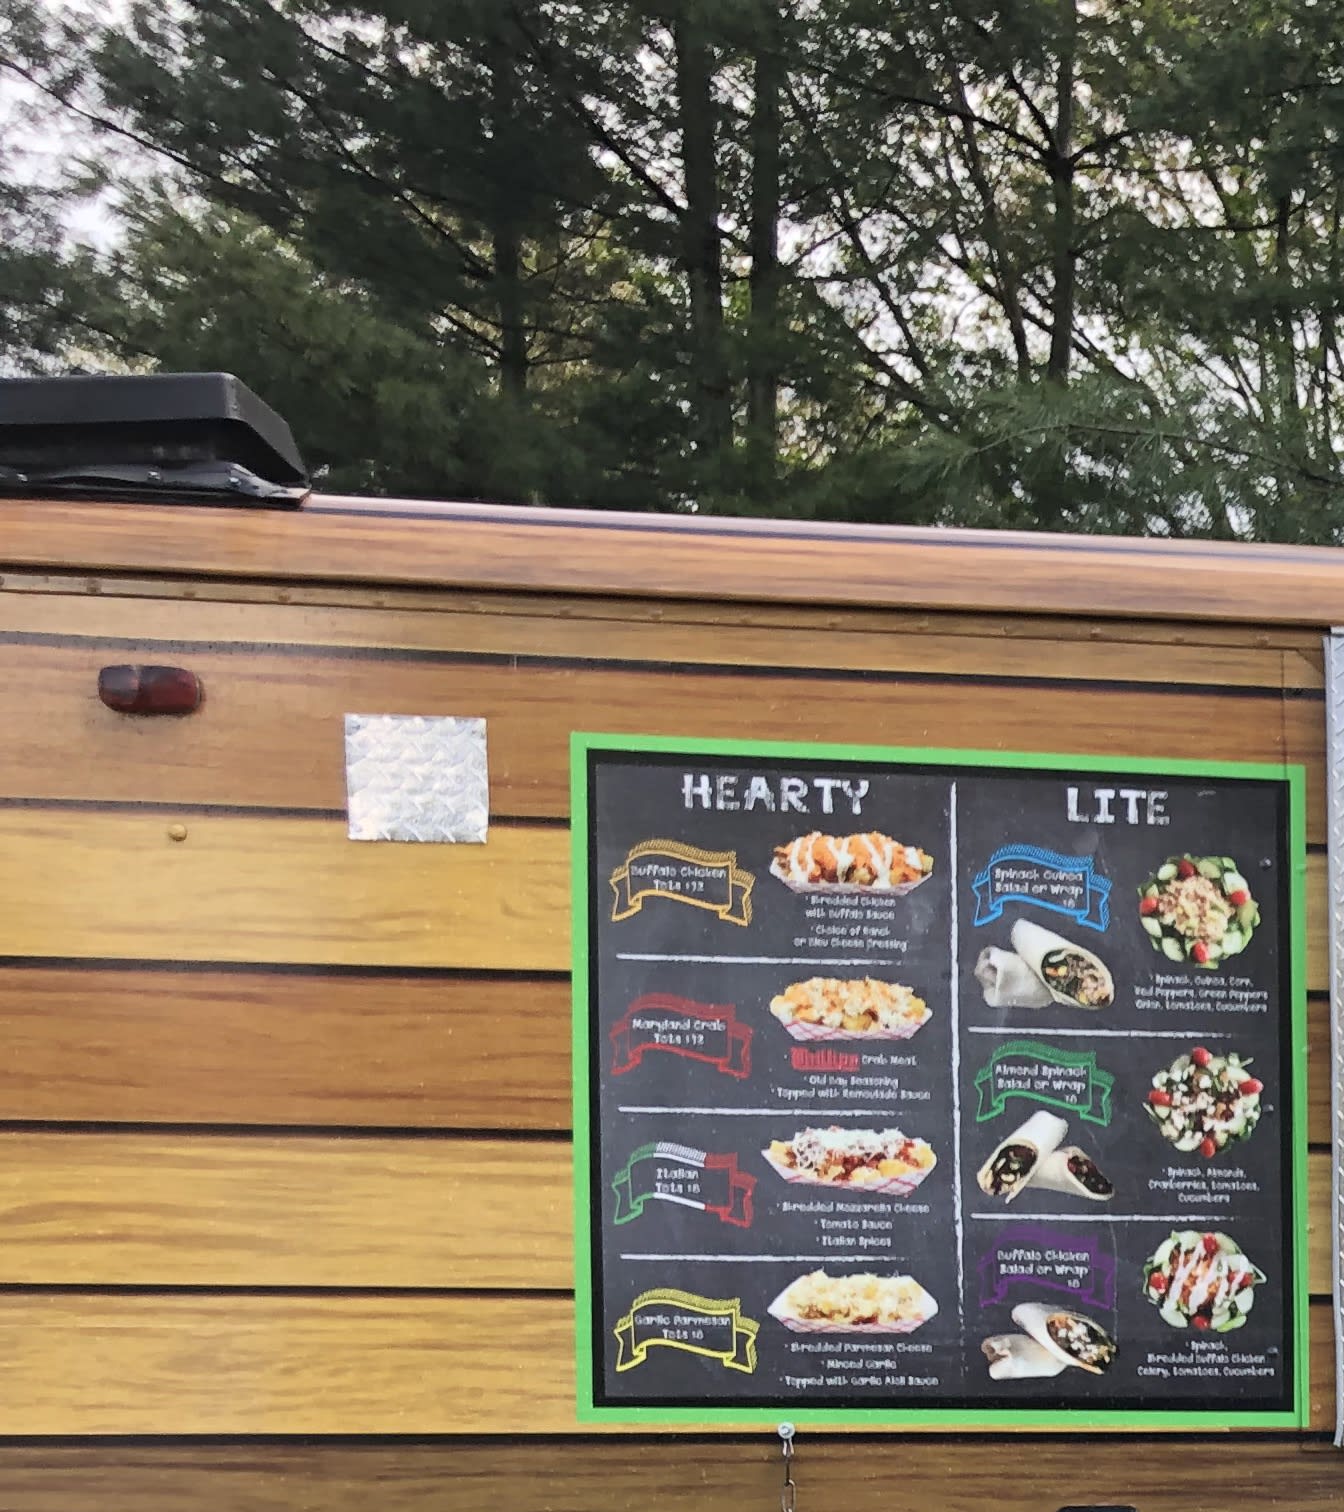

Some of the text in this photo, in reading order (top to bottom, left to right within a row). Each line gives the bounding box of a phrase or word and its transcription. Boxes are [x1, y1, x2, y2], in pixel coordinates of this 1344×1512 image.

[681, 773, 870, 816] HEARTY
[1066, 788, 1171, 827] LITE
[631, 864, 727, 879] Buffalo Chicken
[995, 868, 1039, 881] Spinach
[653, 879, 681, 892] Tots
[994, 882, 1084, 898] Salad or Wrap
[632, 1018, 727, 1033] Maryland Crab
[653, 1033, 681, 1045] Tots
[995, 1064, 1087, 1079] Almond Spinach
[808, 1075, 827, 1086] Old
[997, 1078, 1086, 1094] Salad or Wrap
[656, 1168, 699, 1179] Italian
[655, 1182, 684, 1194] Tots
[997, 1248, 1091, 1262] Buffalo Chicken
[999, 1264, 1089, 1279] Salad or Wrap
[634, 1314, 731, 1326] Garlic Parmesan
[661, 1328, 689, 1340] Tots
